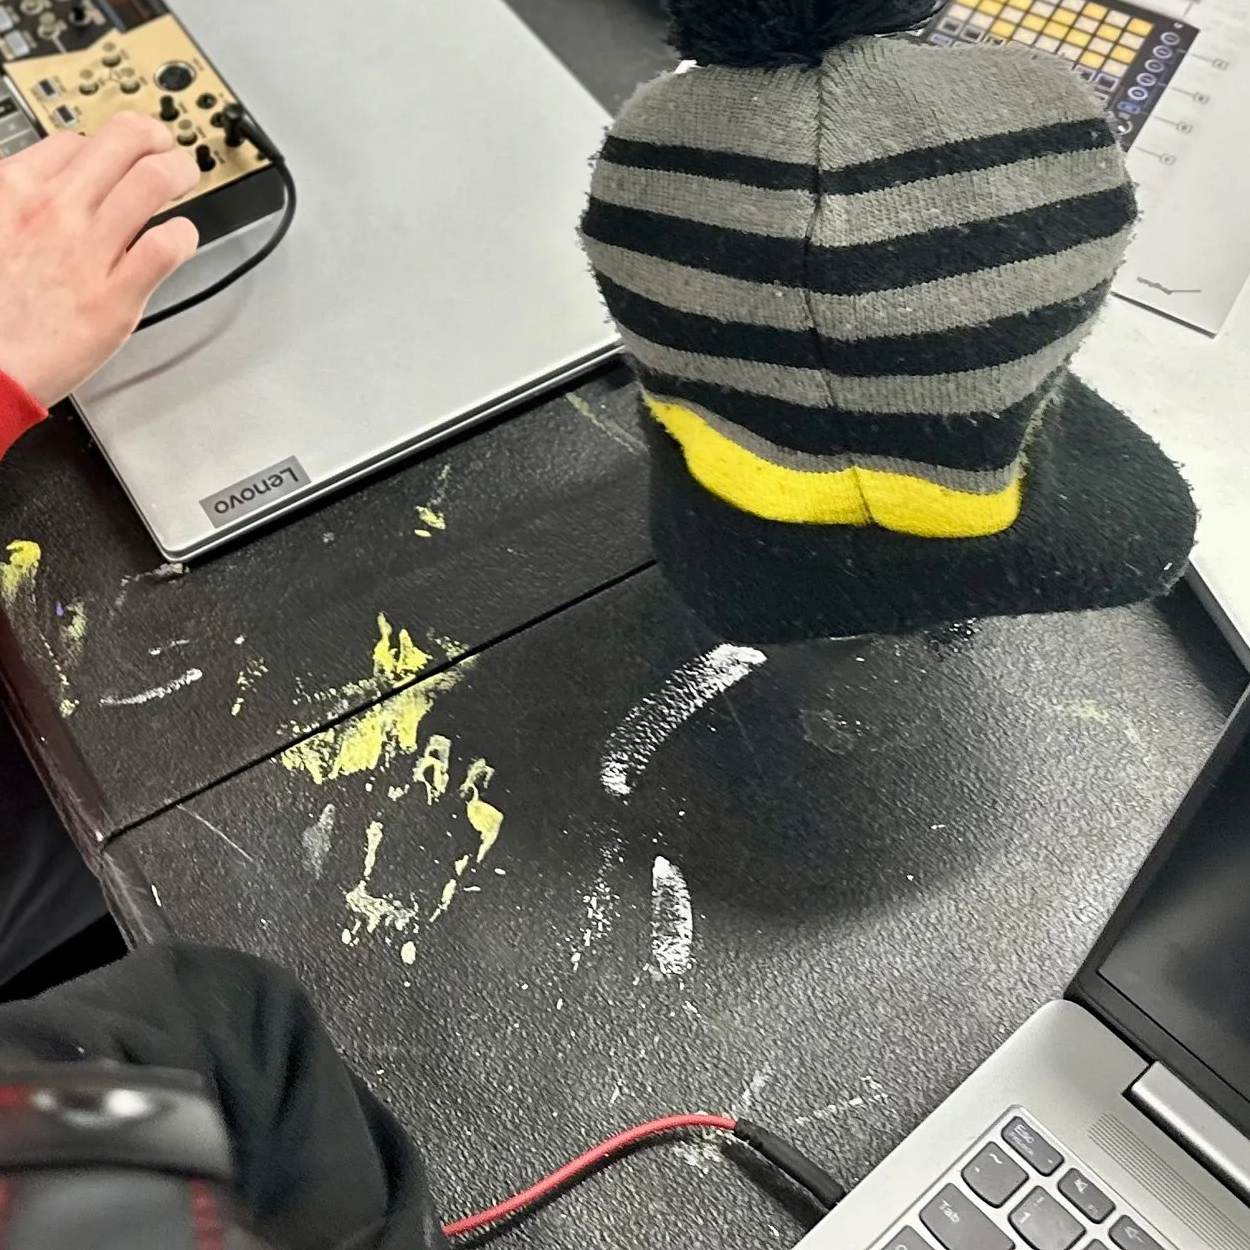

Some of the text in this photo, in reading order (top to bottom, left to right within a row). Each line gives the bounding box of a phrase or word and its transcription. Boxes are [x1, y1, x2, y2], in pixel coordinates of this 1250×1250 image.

[214, 466, 299, 514] Lenovo
[1014, 1124, 1035, 1144] Esc
[939, 1198, 960, 1223] Tab
